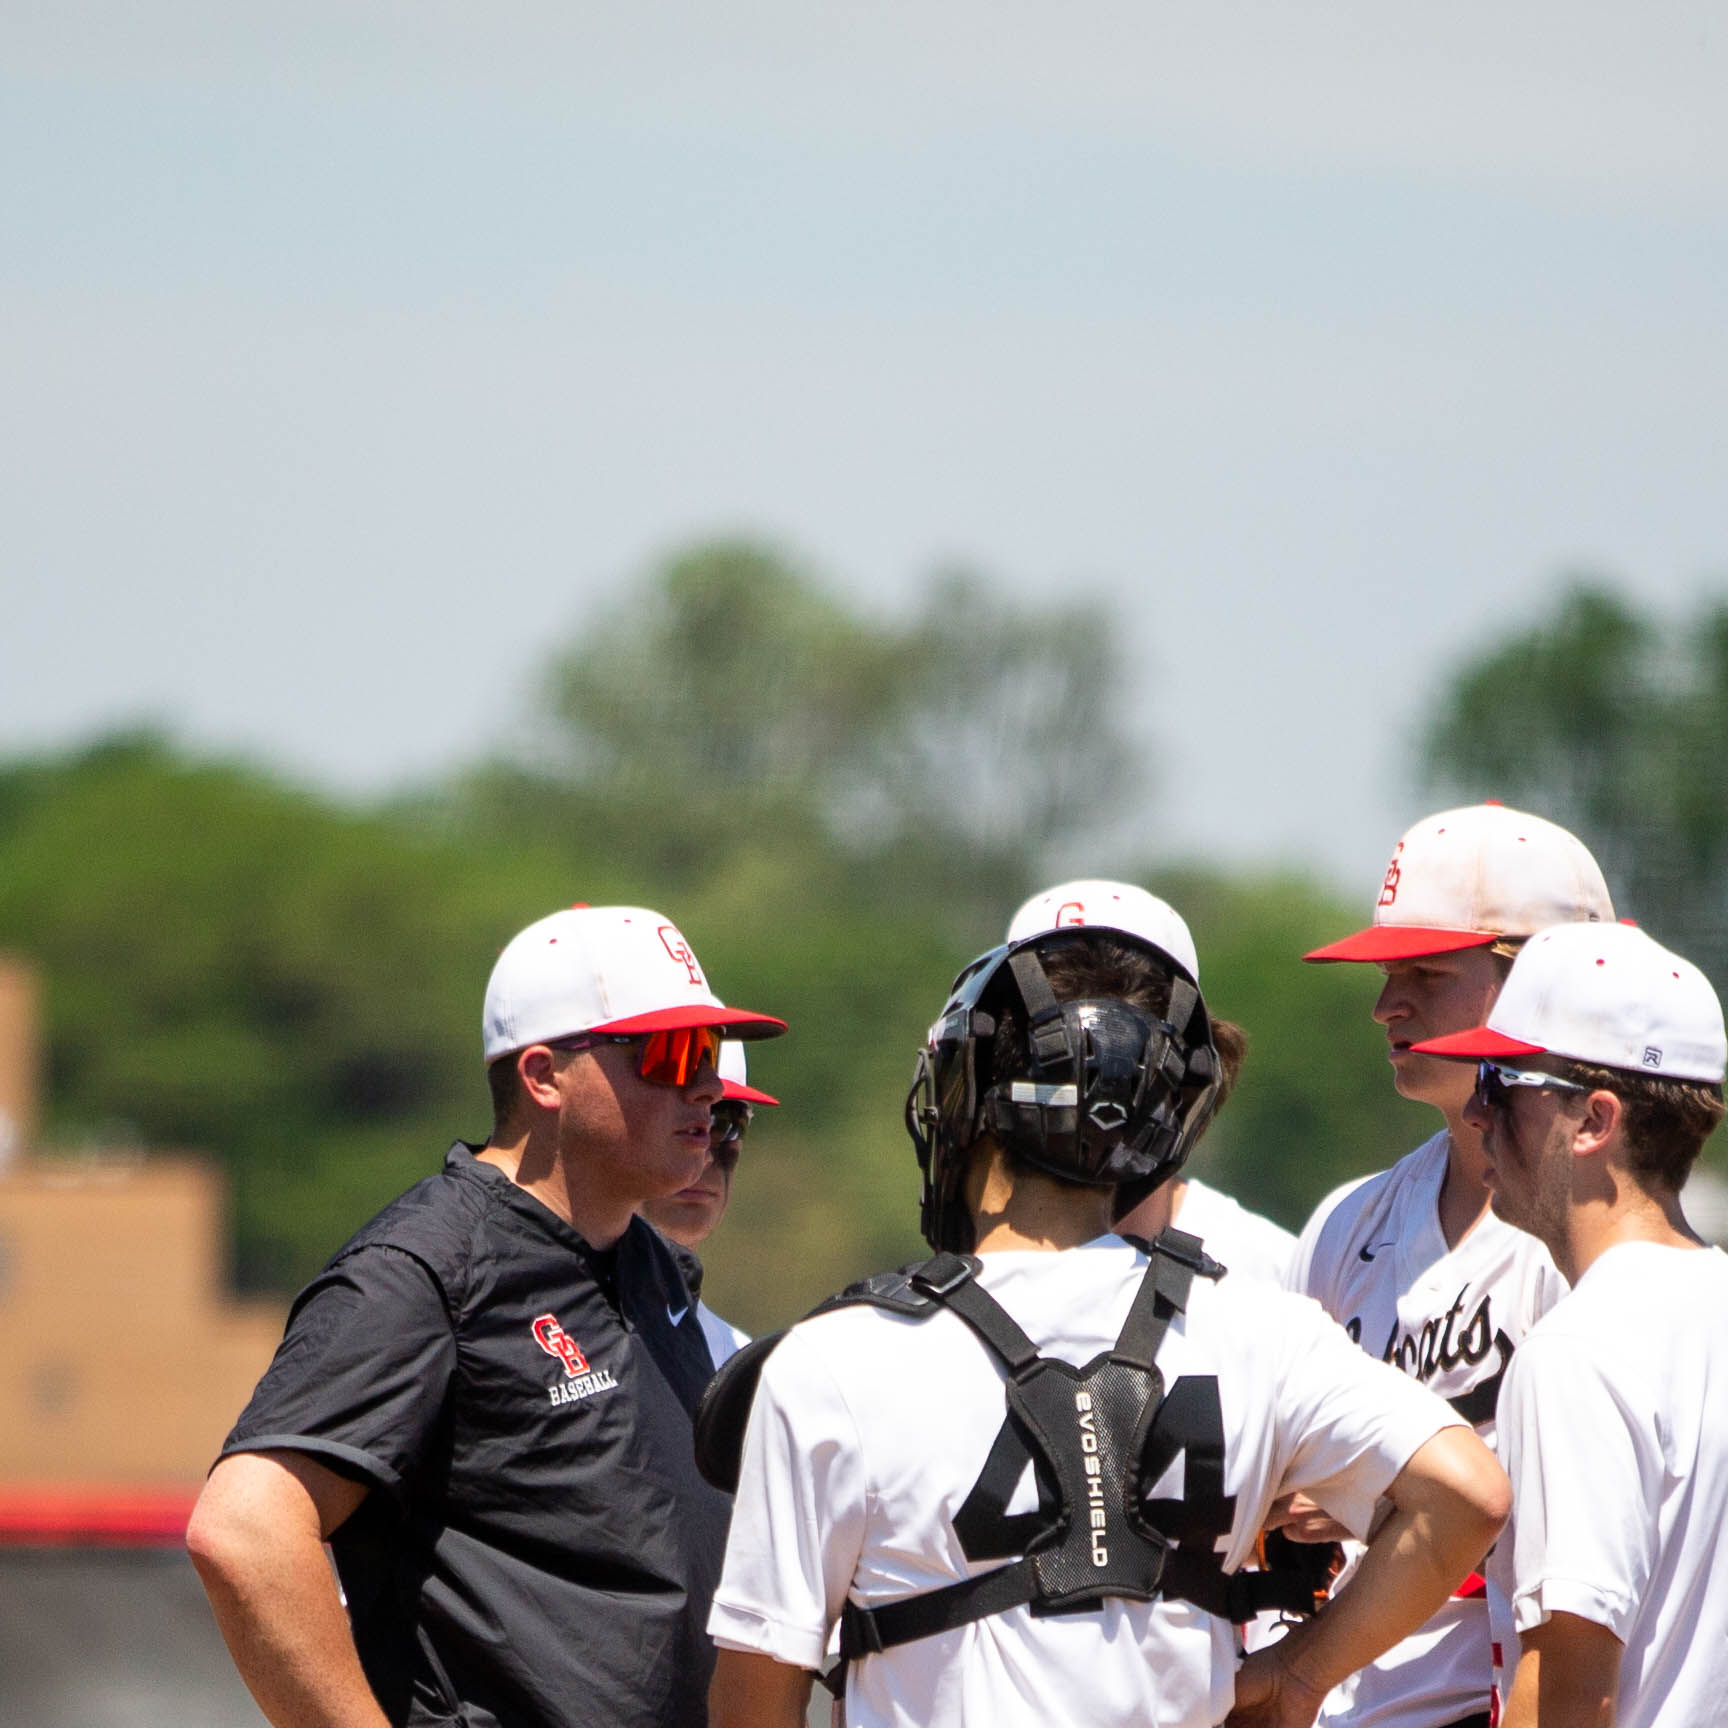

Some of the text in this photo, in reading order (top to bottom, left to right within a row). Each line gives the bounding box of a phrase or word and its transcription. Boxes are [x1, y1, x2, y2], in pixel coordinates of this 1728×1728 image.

[531, 1313, 591, 1378] GB
[548, 1369, 619, 1407] BASEBALL
[952, 1374, 1236, 1619] 44
[1075, 1391, 1108, 1567] EVOSHIELD
